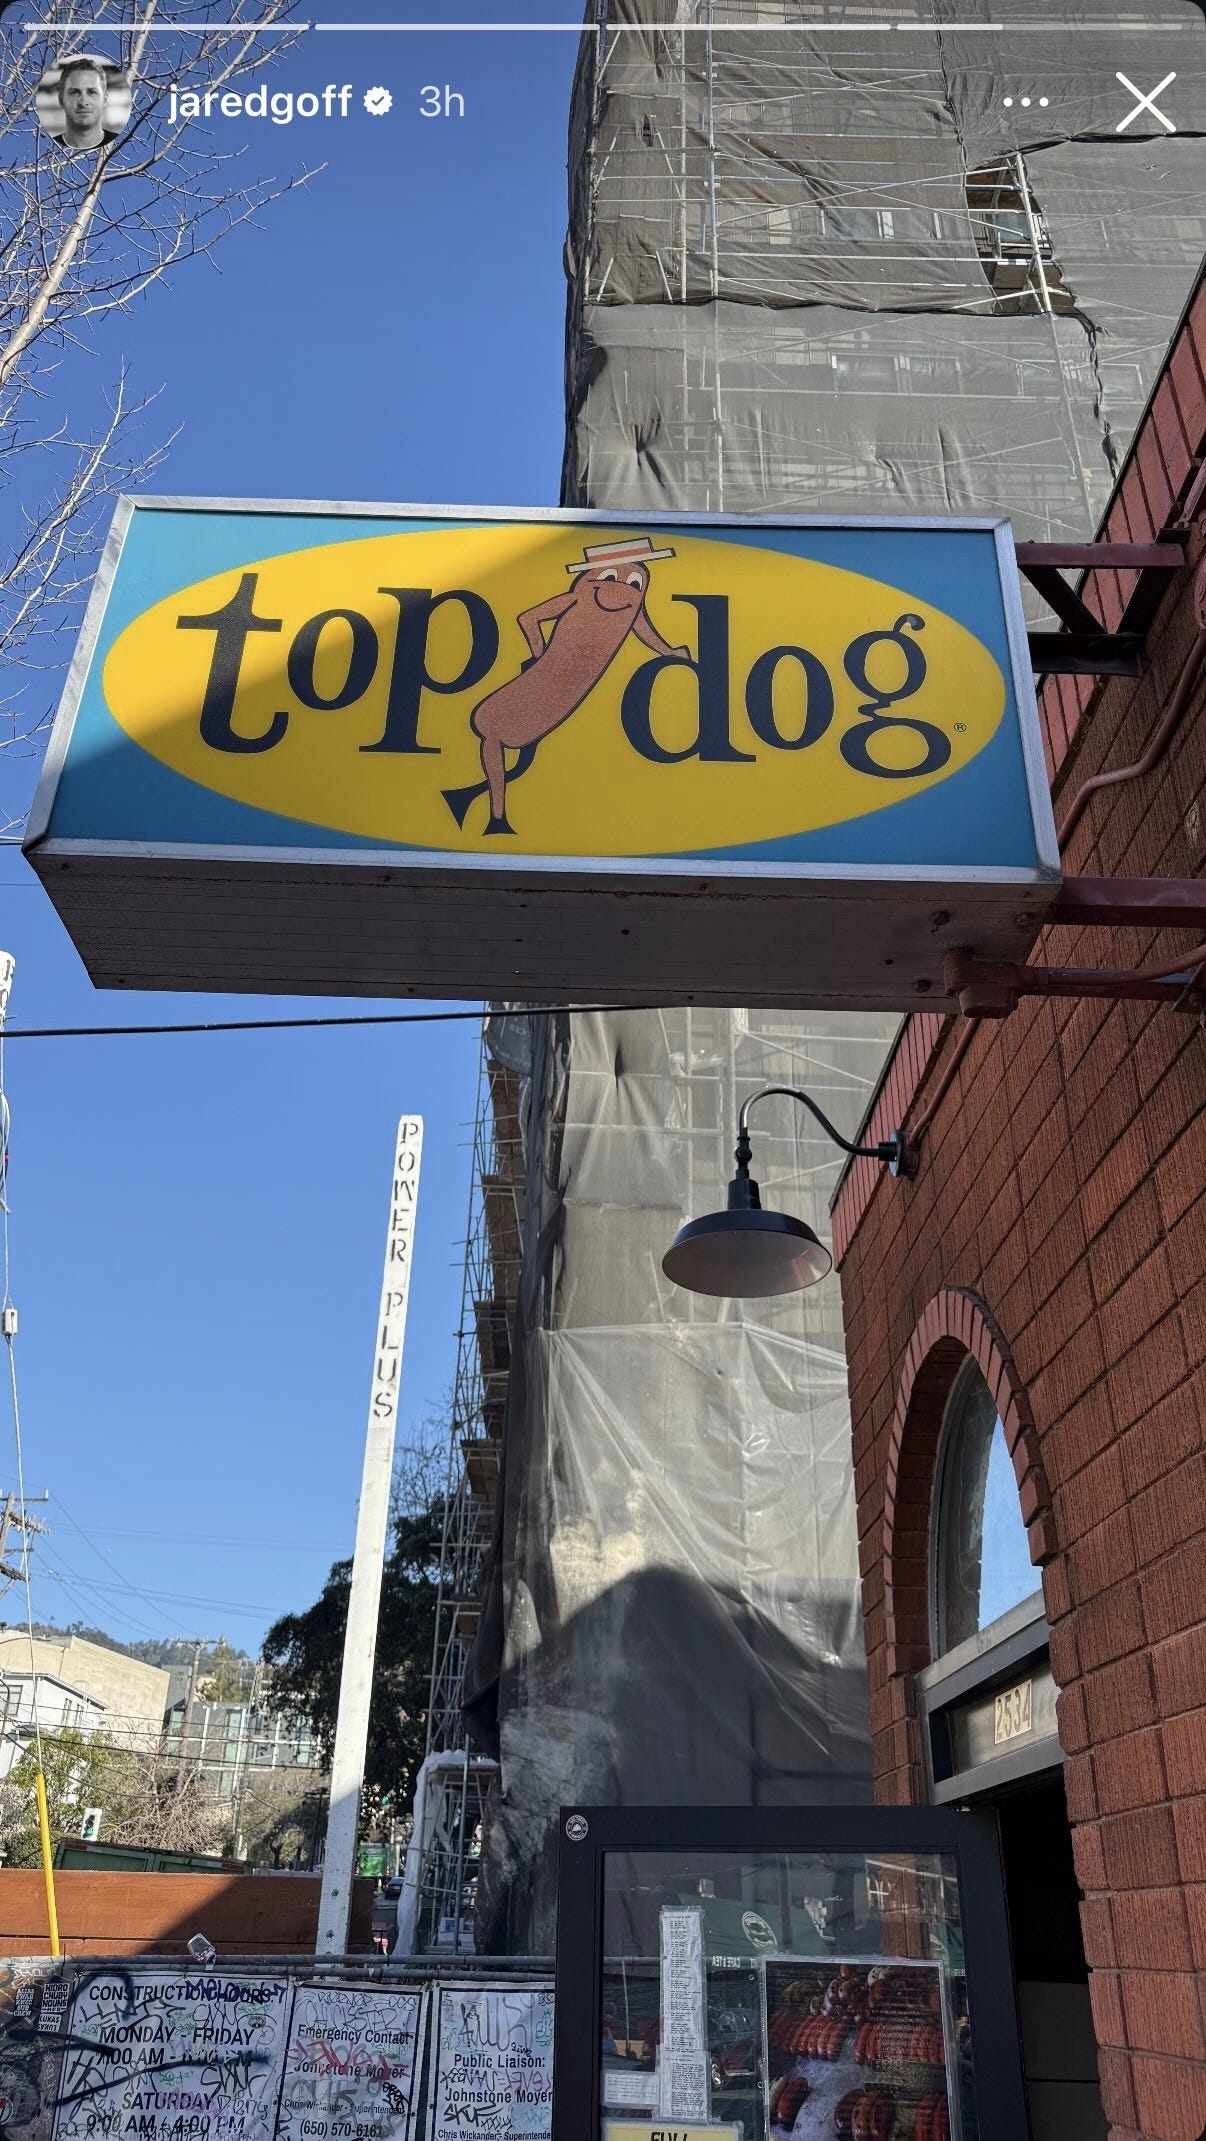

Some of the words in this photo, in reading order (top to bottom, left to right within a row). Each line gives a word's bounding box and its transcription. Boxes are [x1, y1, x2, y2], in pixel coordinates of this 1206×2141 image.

[176, 572, 499, 755] top
[620, 594, 952, 779] dog
[391, 1122, 419, 1263] POWER
[372, 1292, 404, 1418] PLUS
[996, 1683, 1031, 1740] 2534
[99, 2026, 176, 2044] MONDAY
[192, 2028, 255, 2045] FRIDAY
[137, 2048, 165, 2065] AM
[454, 2053, 493, 2068] Public
[497, 2054, 546, 2069] Liaison:
[366, 2064, 405, 2079] Moer
[122, 2092, 214, 2110] SATURDAY
[445, 2088, 512, 2103] Johnstone
[516, 2090, 553, 2106] Moyer
[300, 2119, 328, 2138] (650)
[438, 2129, 458, 2139] Chris
